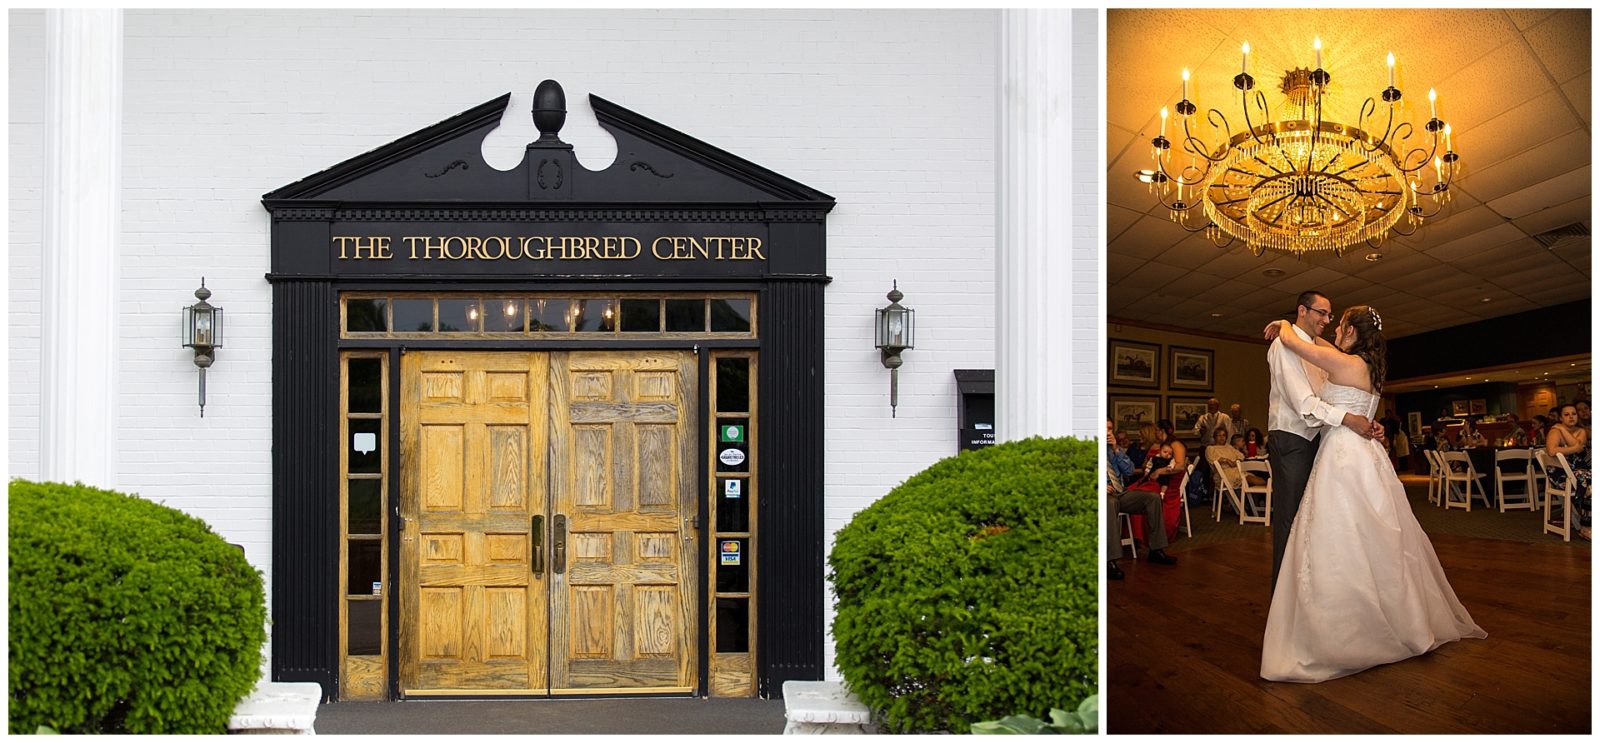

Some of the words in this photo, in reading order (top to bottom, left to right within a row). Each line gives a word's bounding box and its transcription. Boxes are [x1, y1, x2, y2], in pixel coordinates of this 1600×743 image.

[333, 236, 393, 260] THE
[403, 236, 641, 261] THOROUGHBRED
[652, 236, 766, 261] CENTER
